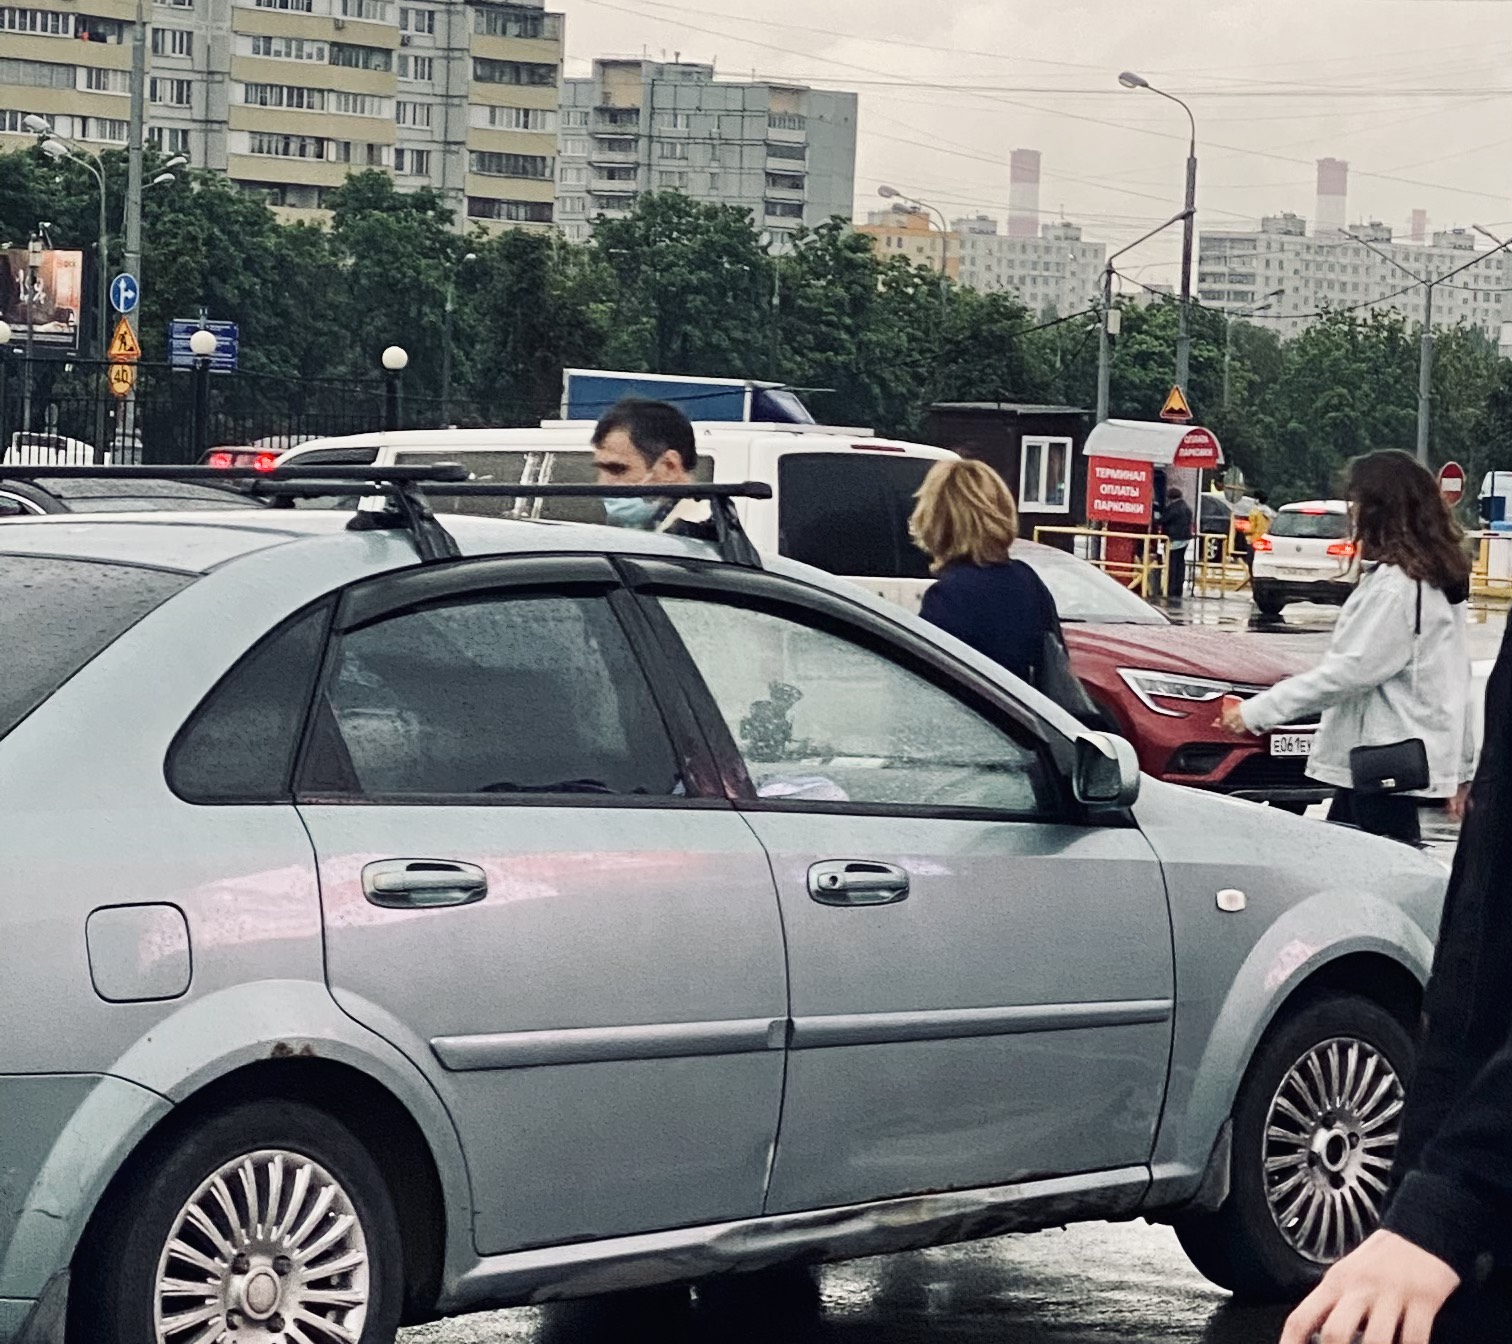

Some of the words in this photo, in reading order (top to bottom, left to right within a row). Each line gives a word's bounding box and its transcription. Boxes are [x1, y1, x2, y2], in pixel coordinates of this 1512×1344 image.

[114, 367, 128, 383] 40
[1179, 449, 1213, 457] ПАРКОВКИ
[1096, 468, 1146, 481] ТЕРМИНАЛ
[1100, 484, 1139, 497] ОПЛАТЫ
[1094, 500, 1144, 514] ПАРКОВКИ
